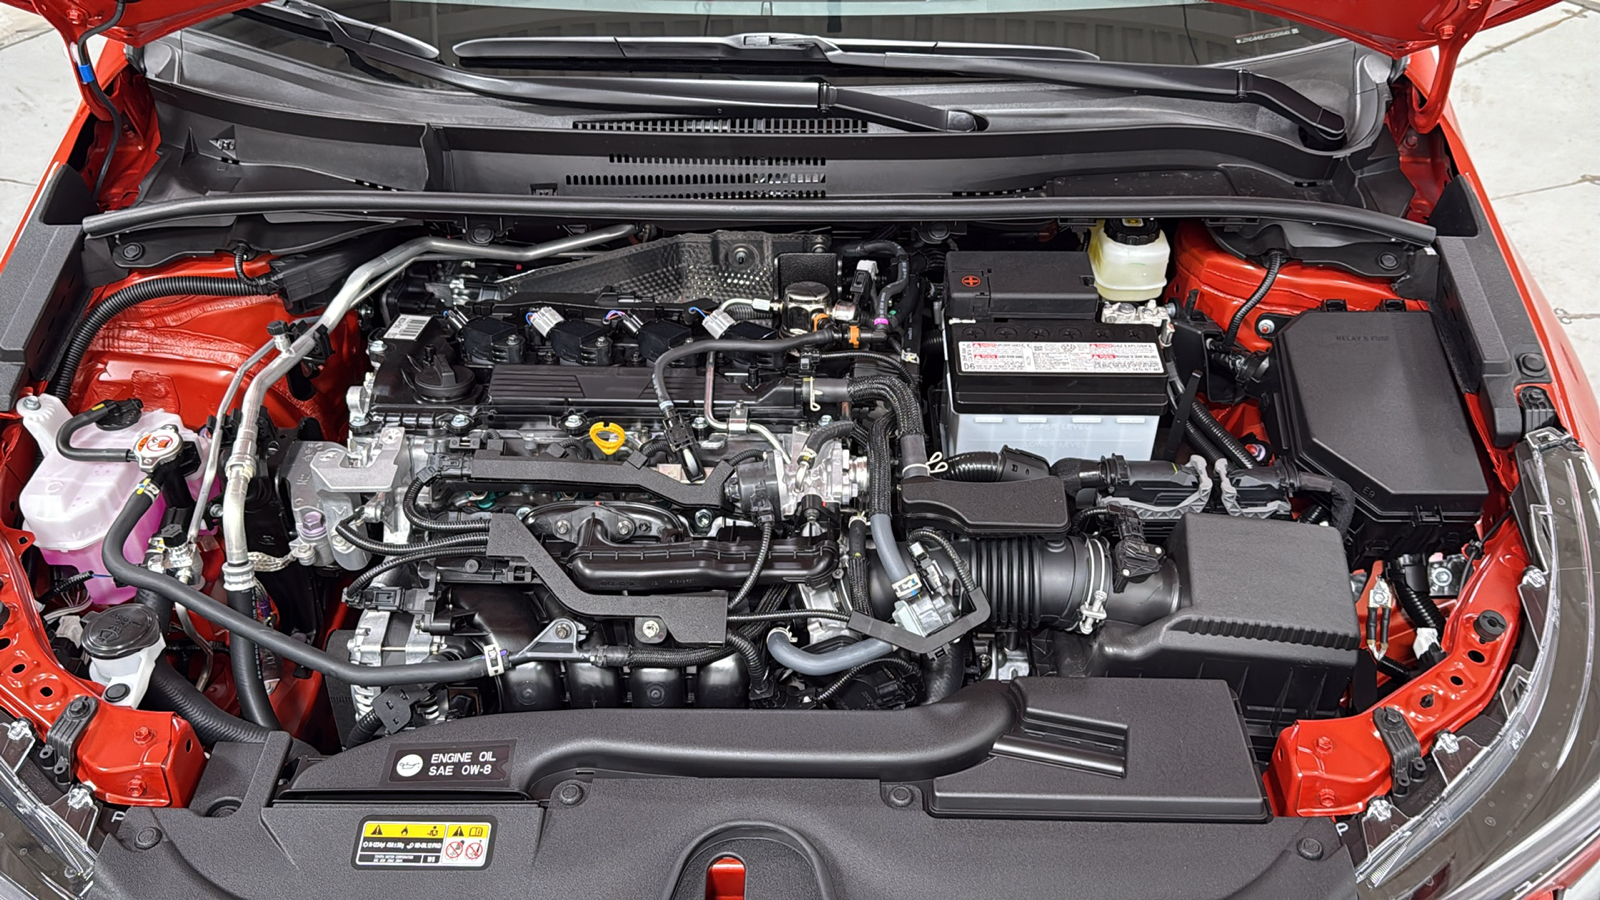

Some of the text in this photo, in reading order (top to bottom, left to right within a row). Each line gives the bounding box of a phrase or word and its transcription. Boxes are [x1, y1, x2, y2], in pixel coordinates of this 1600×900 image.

[430, 751, 496, 764] ENGINE OIL
[428, 764, 492, 776] SAE 0W-8
